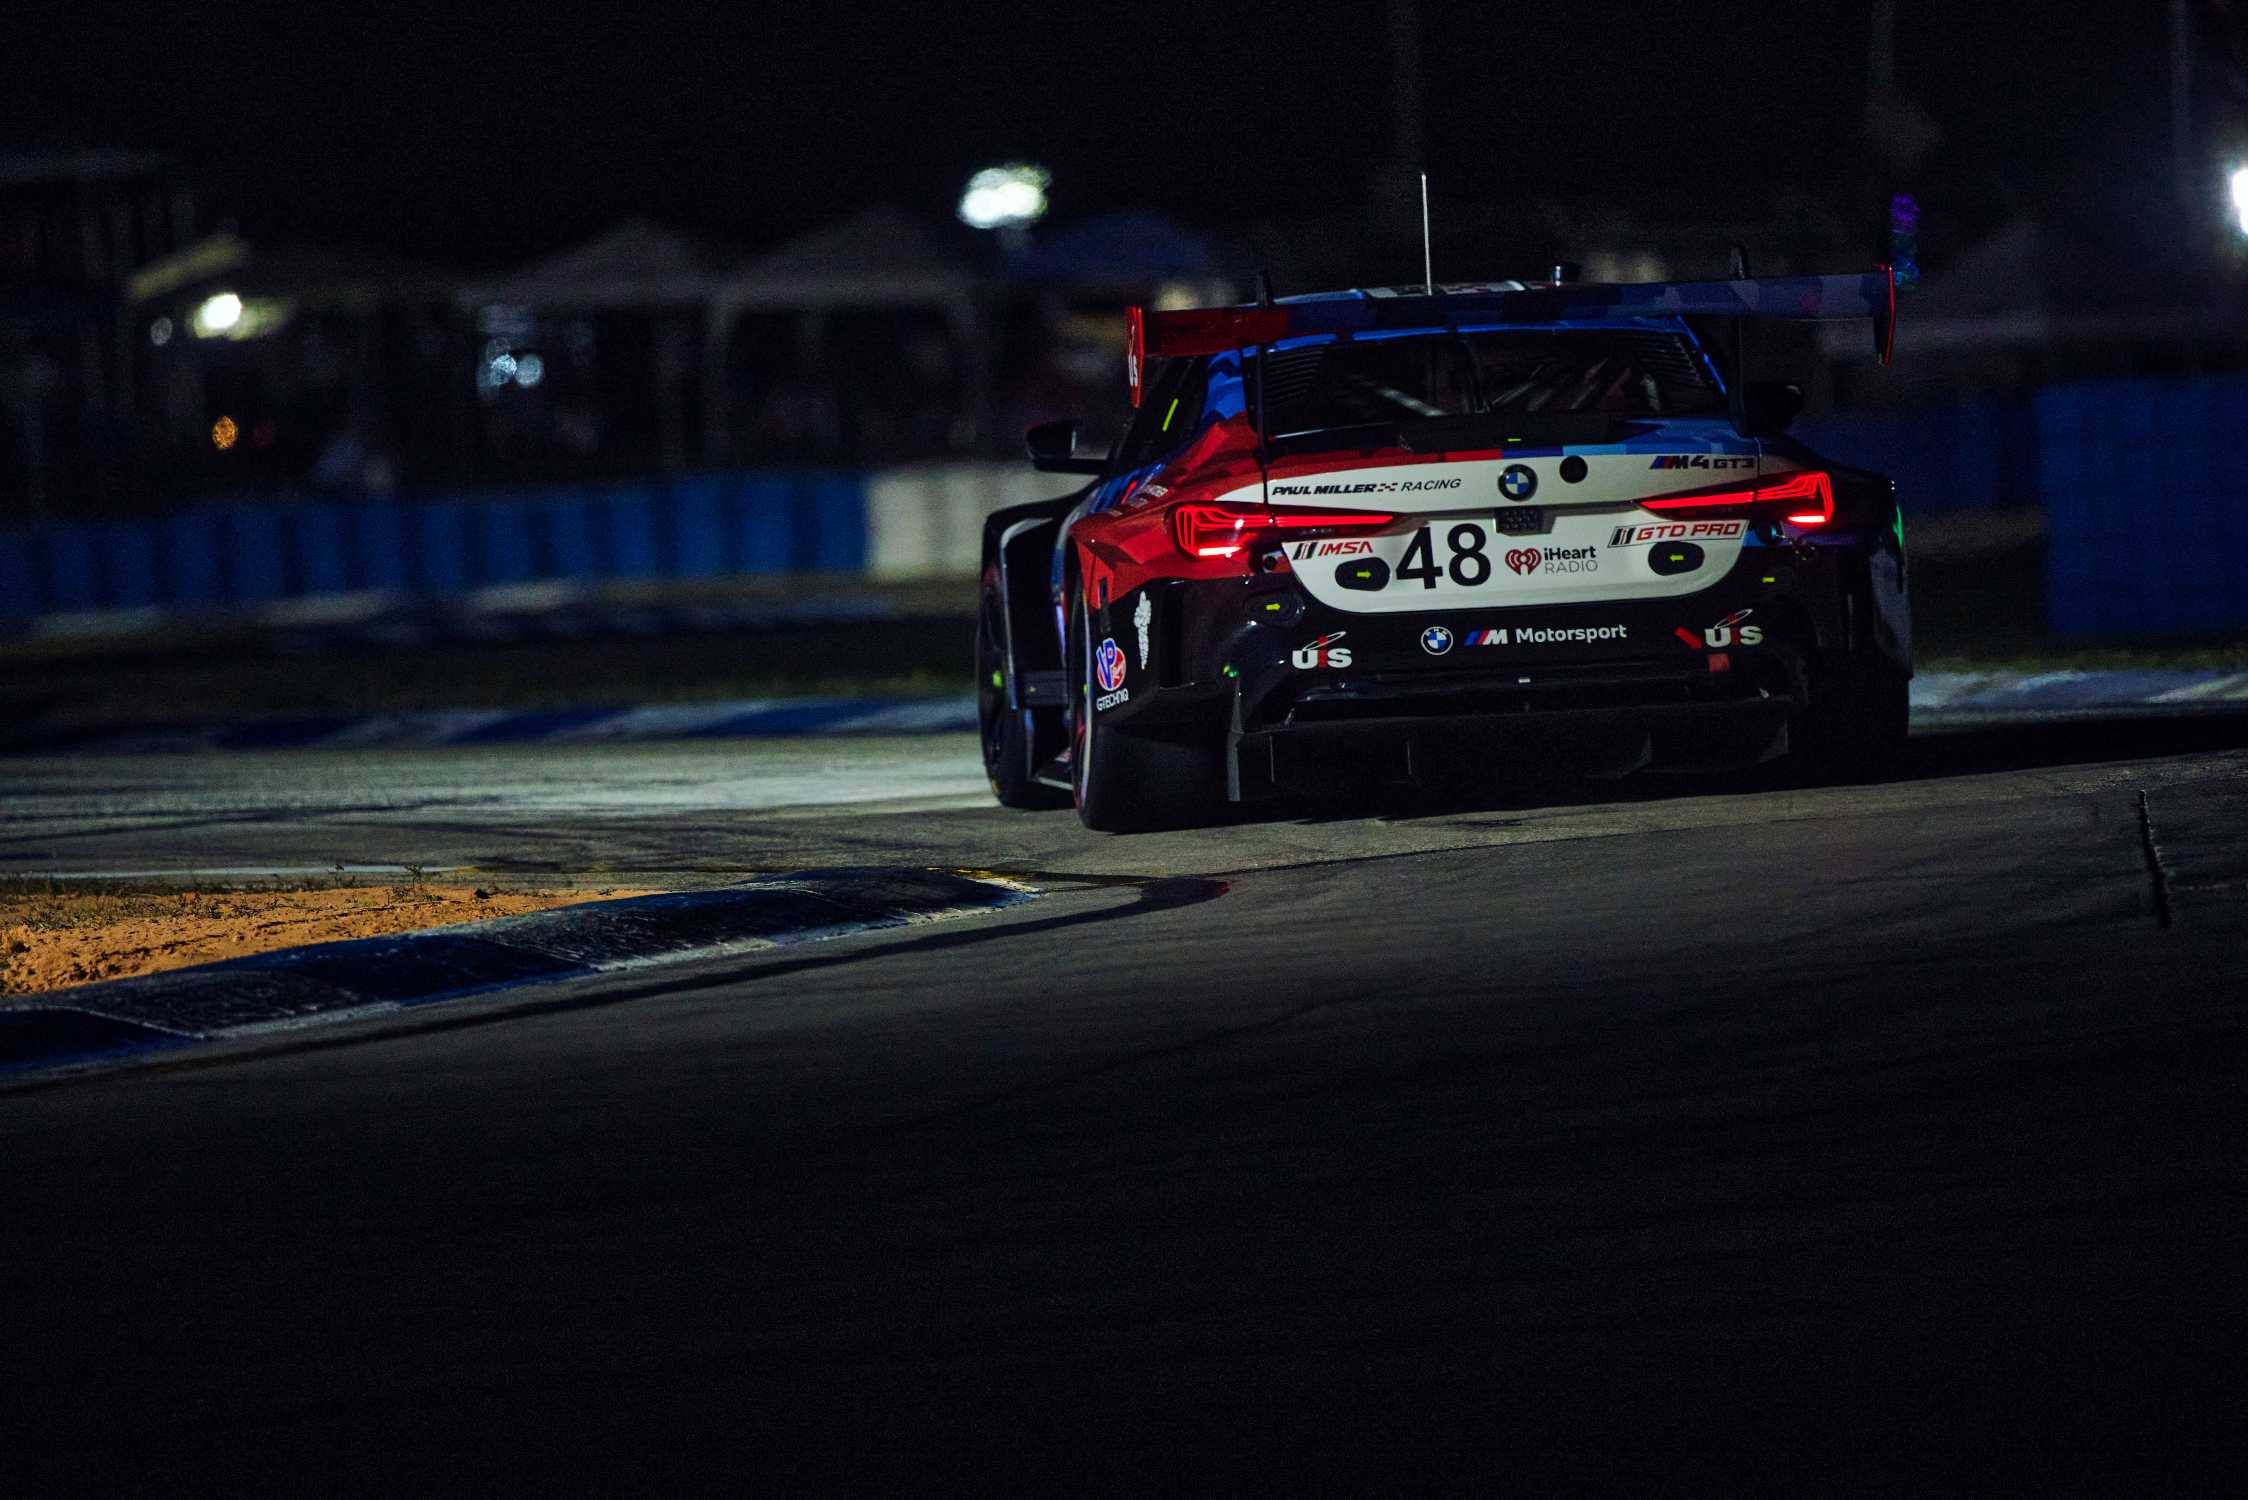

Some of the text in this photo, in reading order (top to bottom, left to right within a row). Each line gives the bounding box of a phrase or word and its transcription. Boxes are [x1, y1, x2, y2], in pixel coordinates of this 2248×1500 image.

[1272, 478, 1462, 496] PAUL MILLER RACING
[1637, 522, 1740, 541] GTD PRO
[1318, 541, 1374, 557] IMSA
[1395, 523, 1492, 590] 48
[1544, 546, 1597, 561] iHeart
[1545, 559, 1598, 574] RADIO
[1516, 624, 1628, 644] Motorsport
